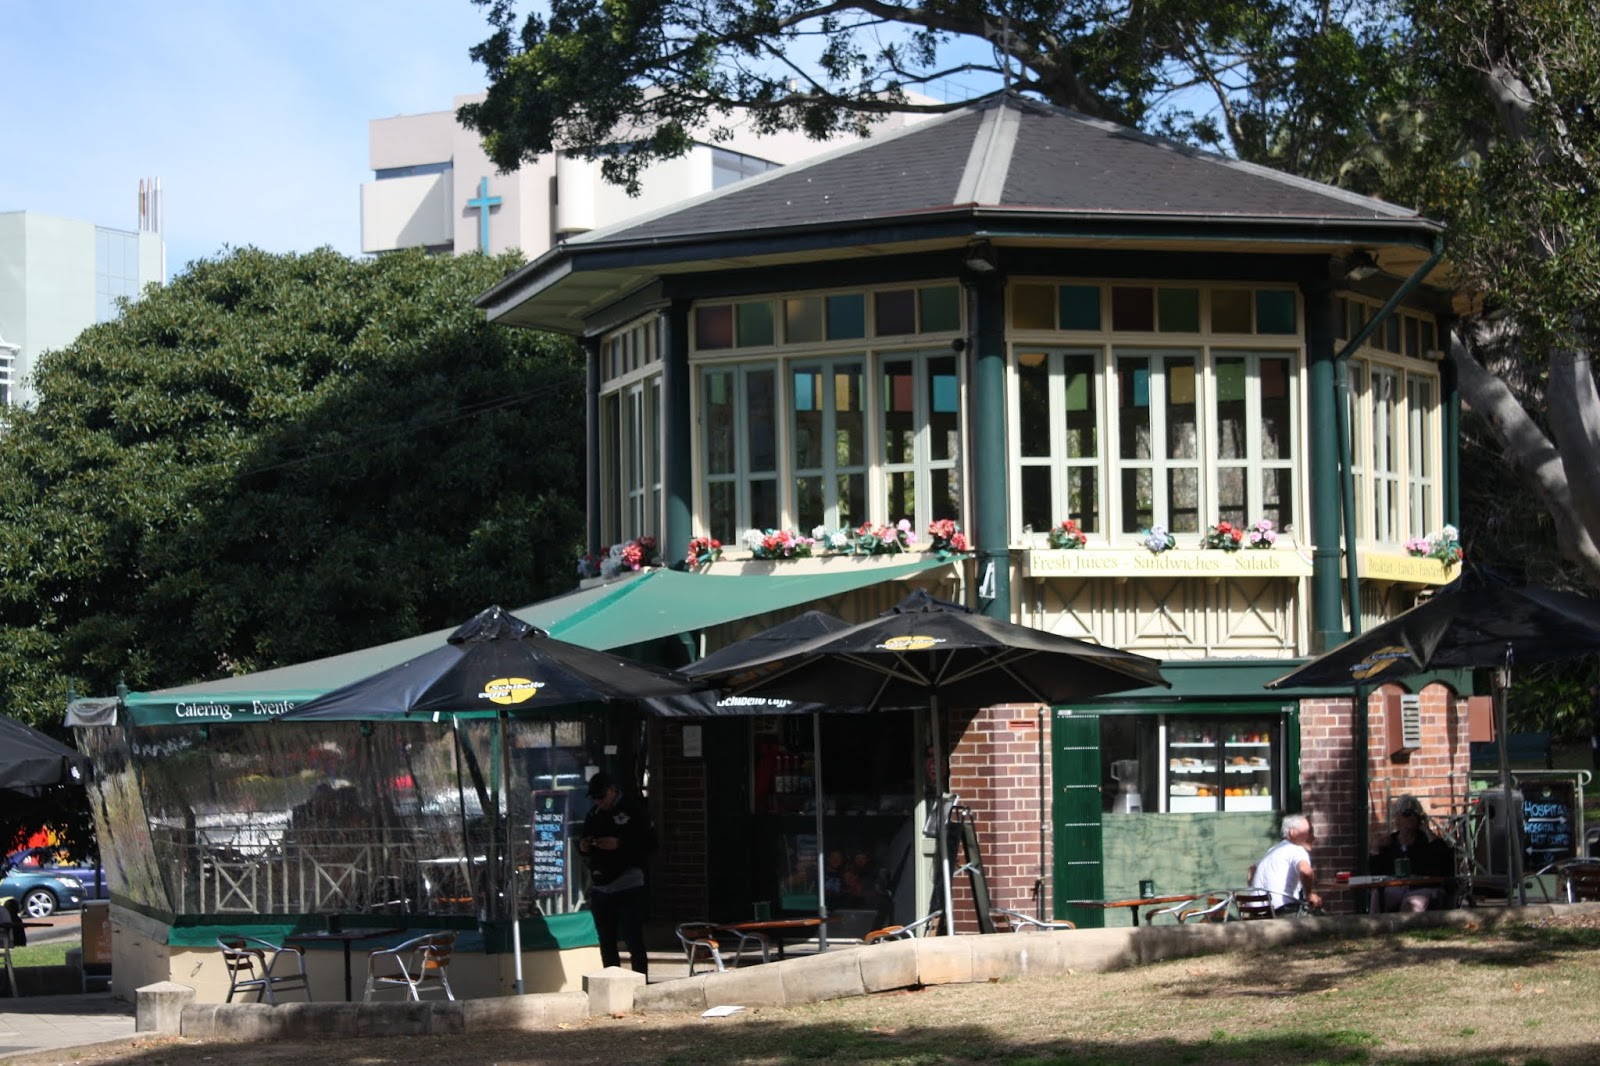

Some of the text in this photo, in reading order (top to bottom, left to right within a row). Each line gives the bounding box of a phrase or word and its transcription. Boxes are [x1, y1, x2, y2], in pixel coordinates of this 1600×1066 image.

[1032, 555, 1071, 570] Fresh
[1074, 555, 1118, 573] Juices
[1134, 555, 1219, 571] Sandwiches
[1235, 555, 1280, 571] Salads
[175, 700, 233, 720] Catering
